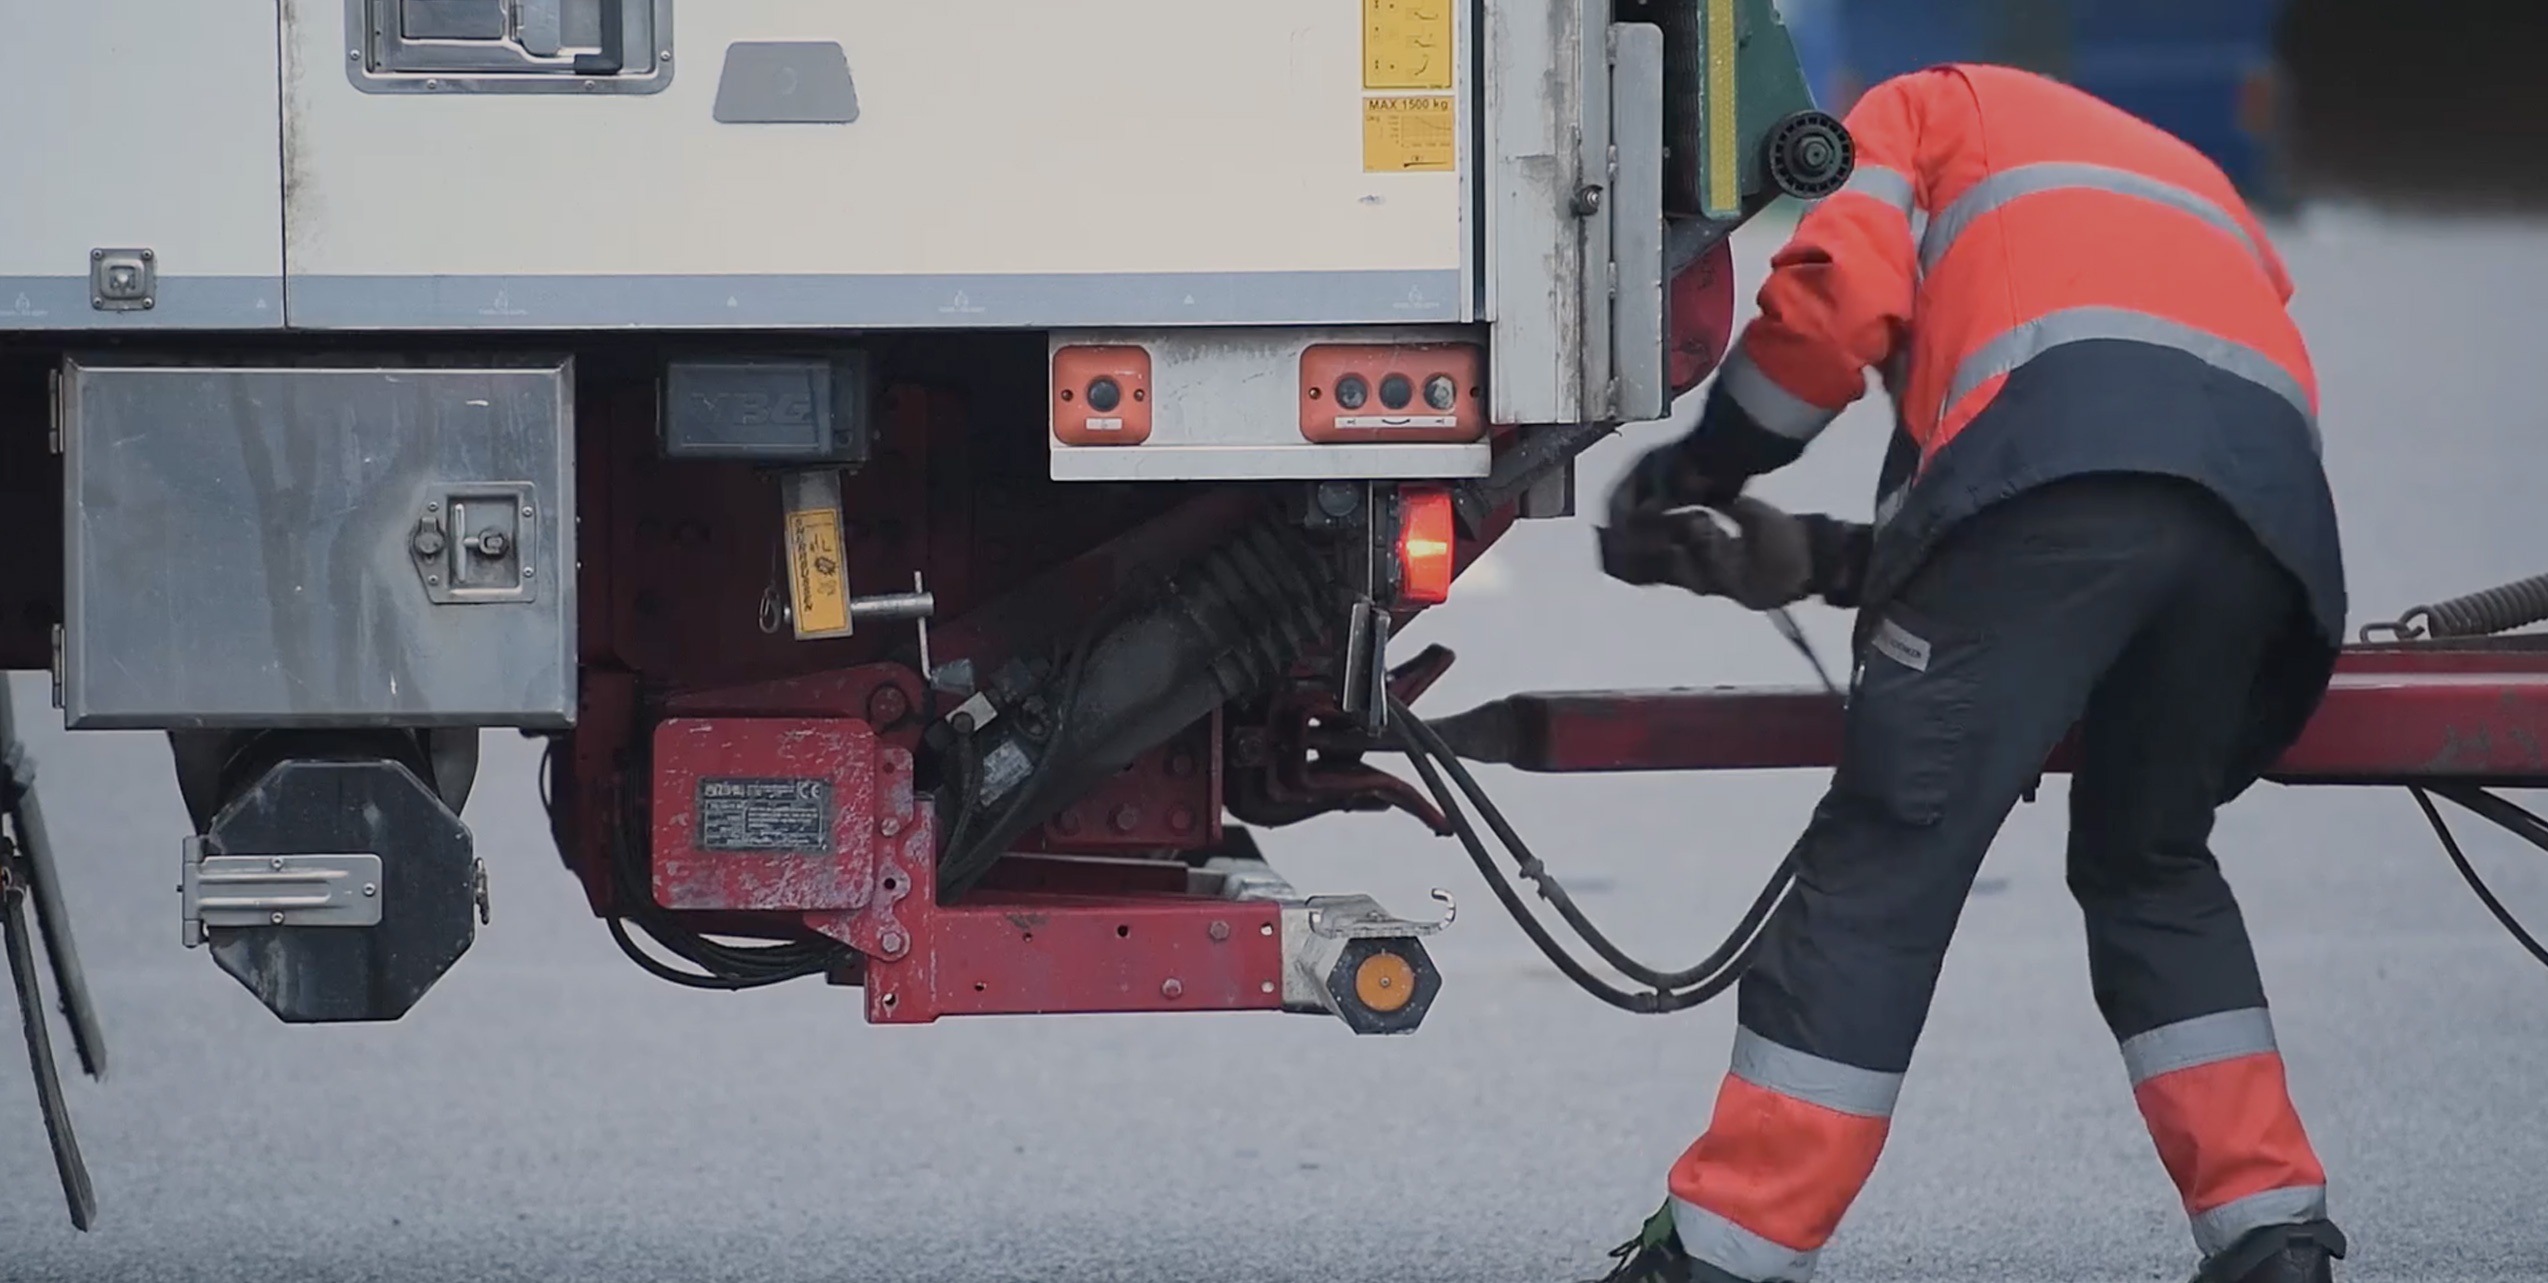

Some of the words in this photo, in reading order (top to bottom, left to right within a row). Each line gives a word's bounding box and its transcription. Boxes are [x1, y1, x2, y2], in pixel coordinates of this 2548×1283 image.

[1369, 99, 1397, 110] MAX
[1402, 99, 1429, 110] 1500
[1433, 98, 1448, 112] kg
